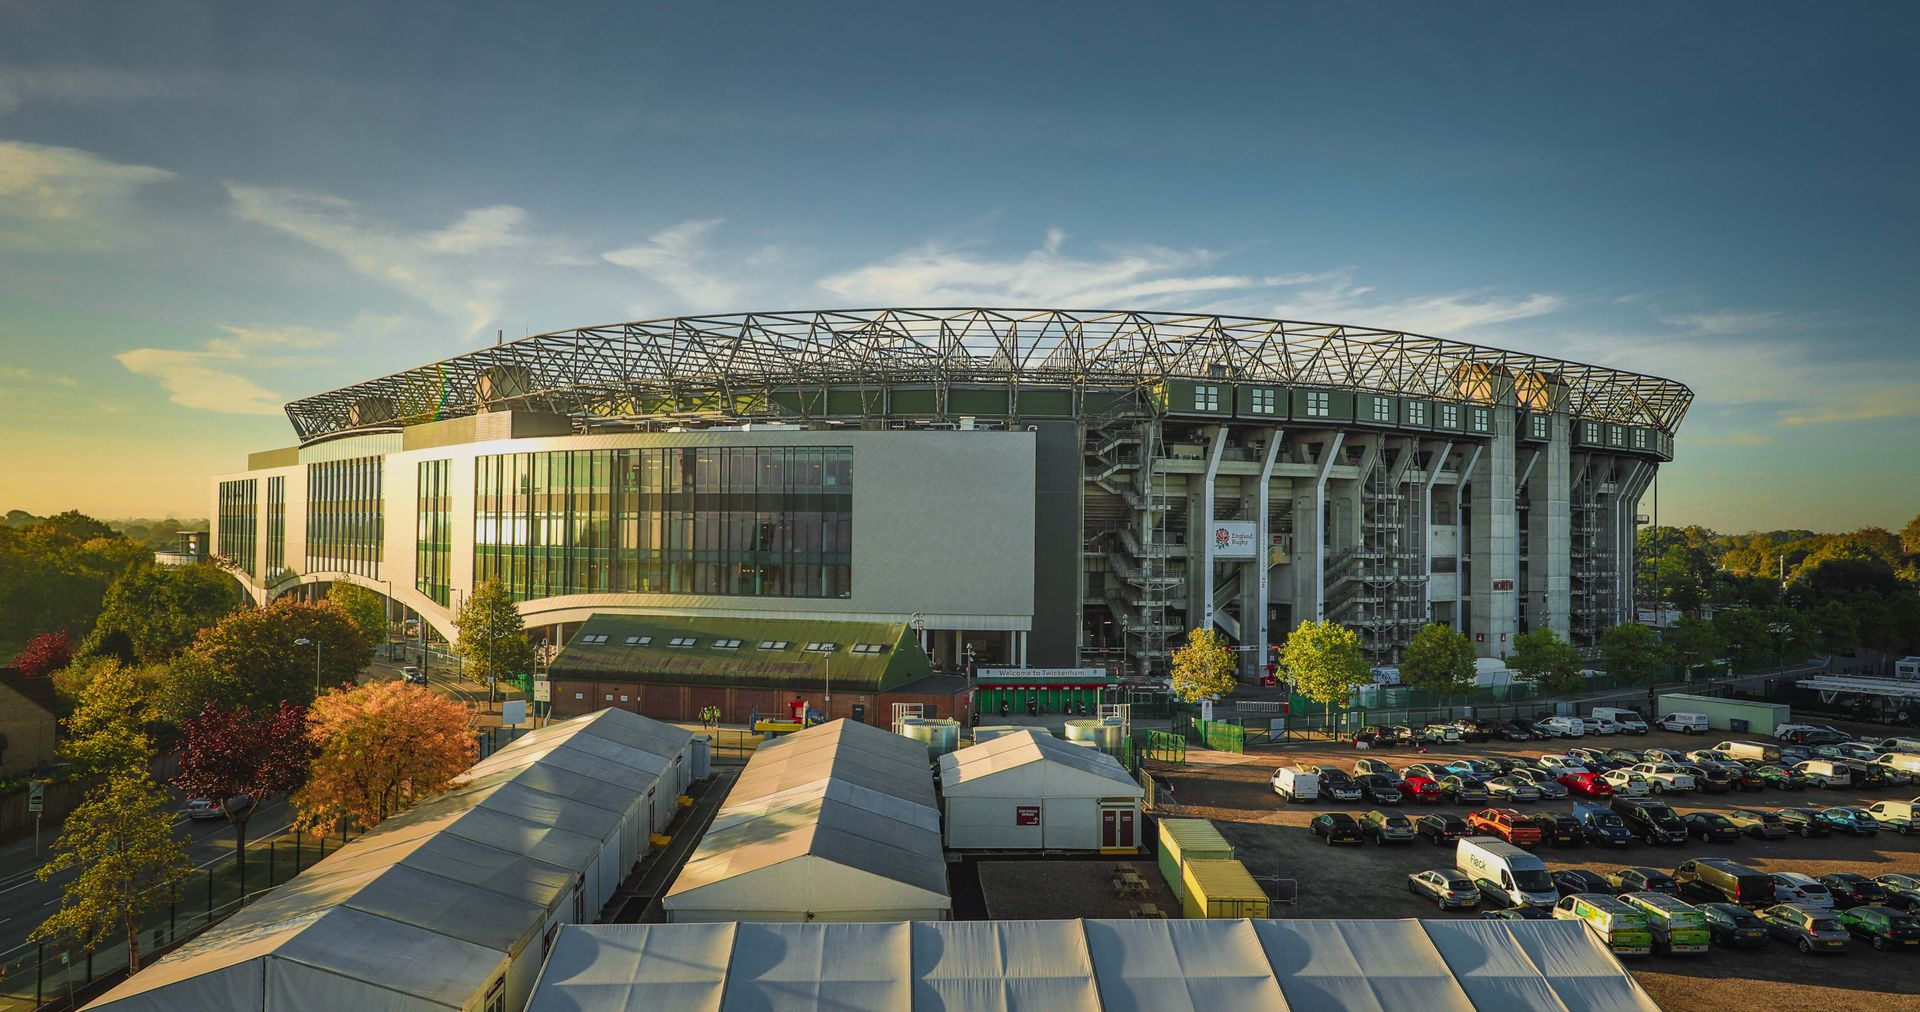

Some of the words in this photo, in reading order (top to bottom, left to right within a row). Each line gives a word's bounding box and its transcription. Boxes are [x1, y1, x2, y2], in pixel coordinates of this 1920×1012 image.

[1231, 532, 1252, 540] England
[1493, 580, 1513, 591] NORTH
[1470, 854, 1487, 871] Fleck
